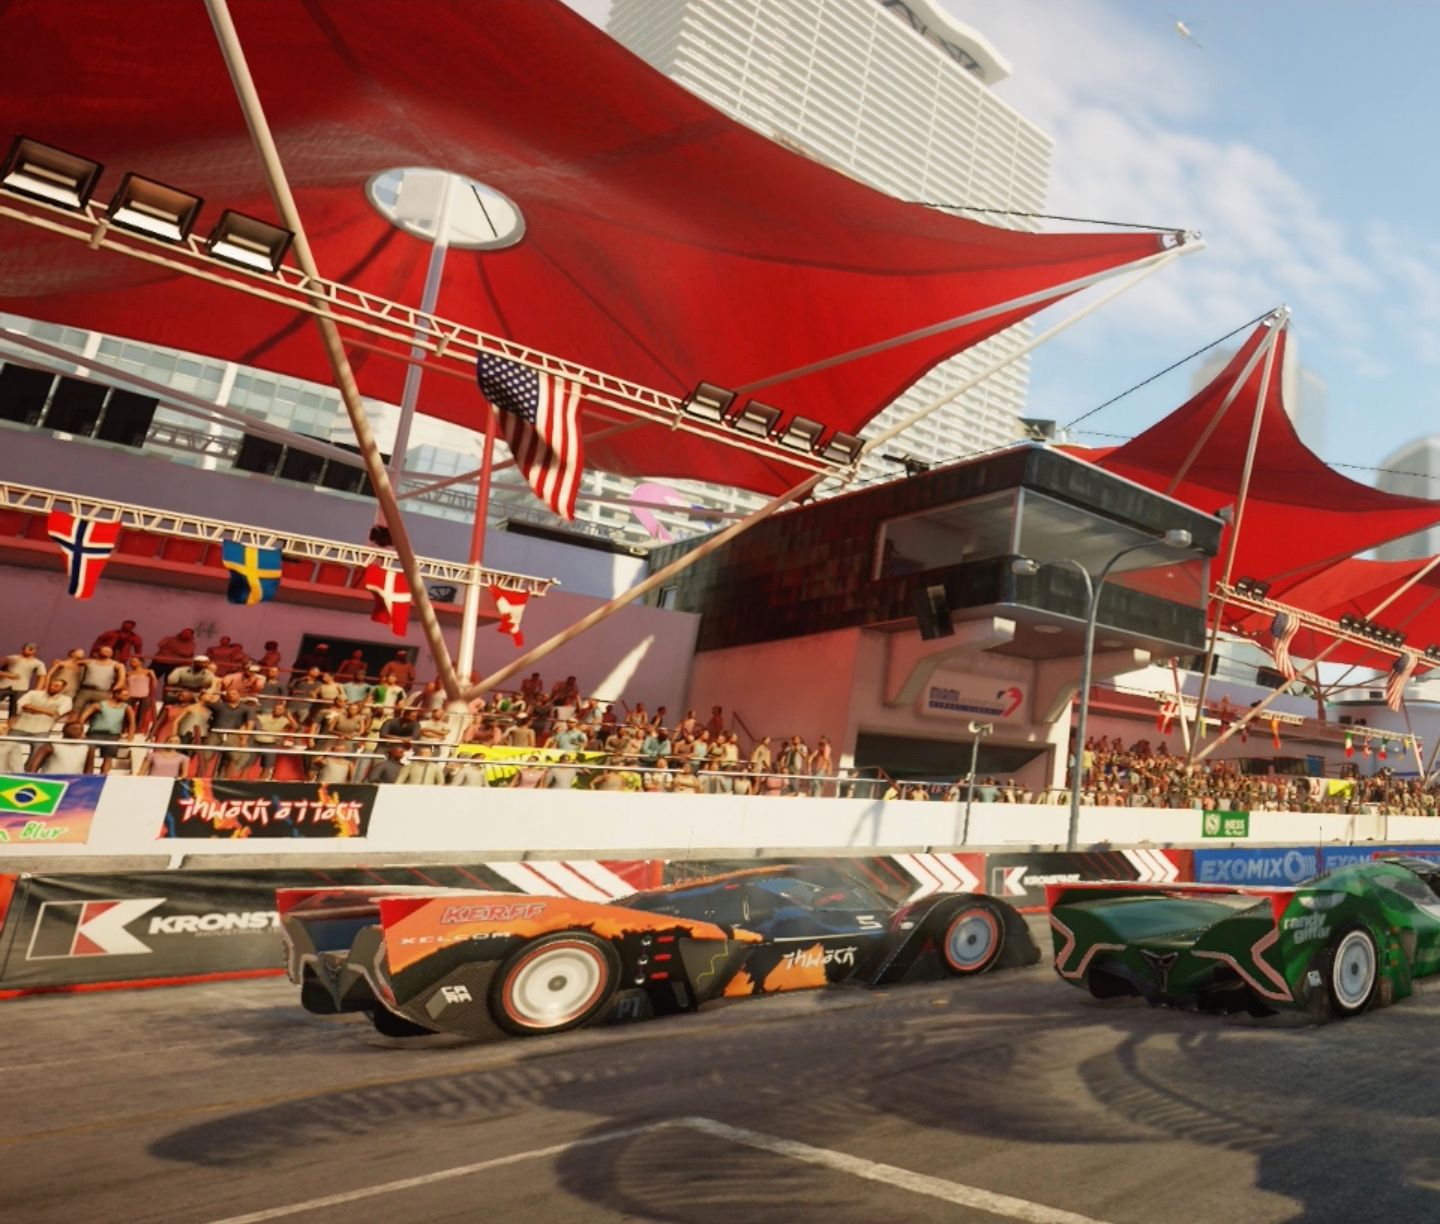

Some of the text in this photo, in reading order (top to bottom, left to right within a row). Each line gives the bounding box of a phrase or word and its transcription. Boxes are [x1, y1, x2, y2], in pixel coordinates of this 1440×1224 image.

[21, 821, 66, 839] Blur
[1201, 857, 1285, 882] EXOMIX
[441, 903, 545, 925] KERFF
[401, 931, 512, 945] KELCOM
